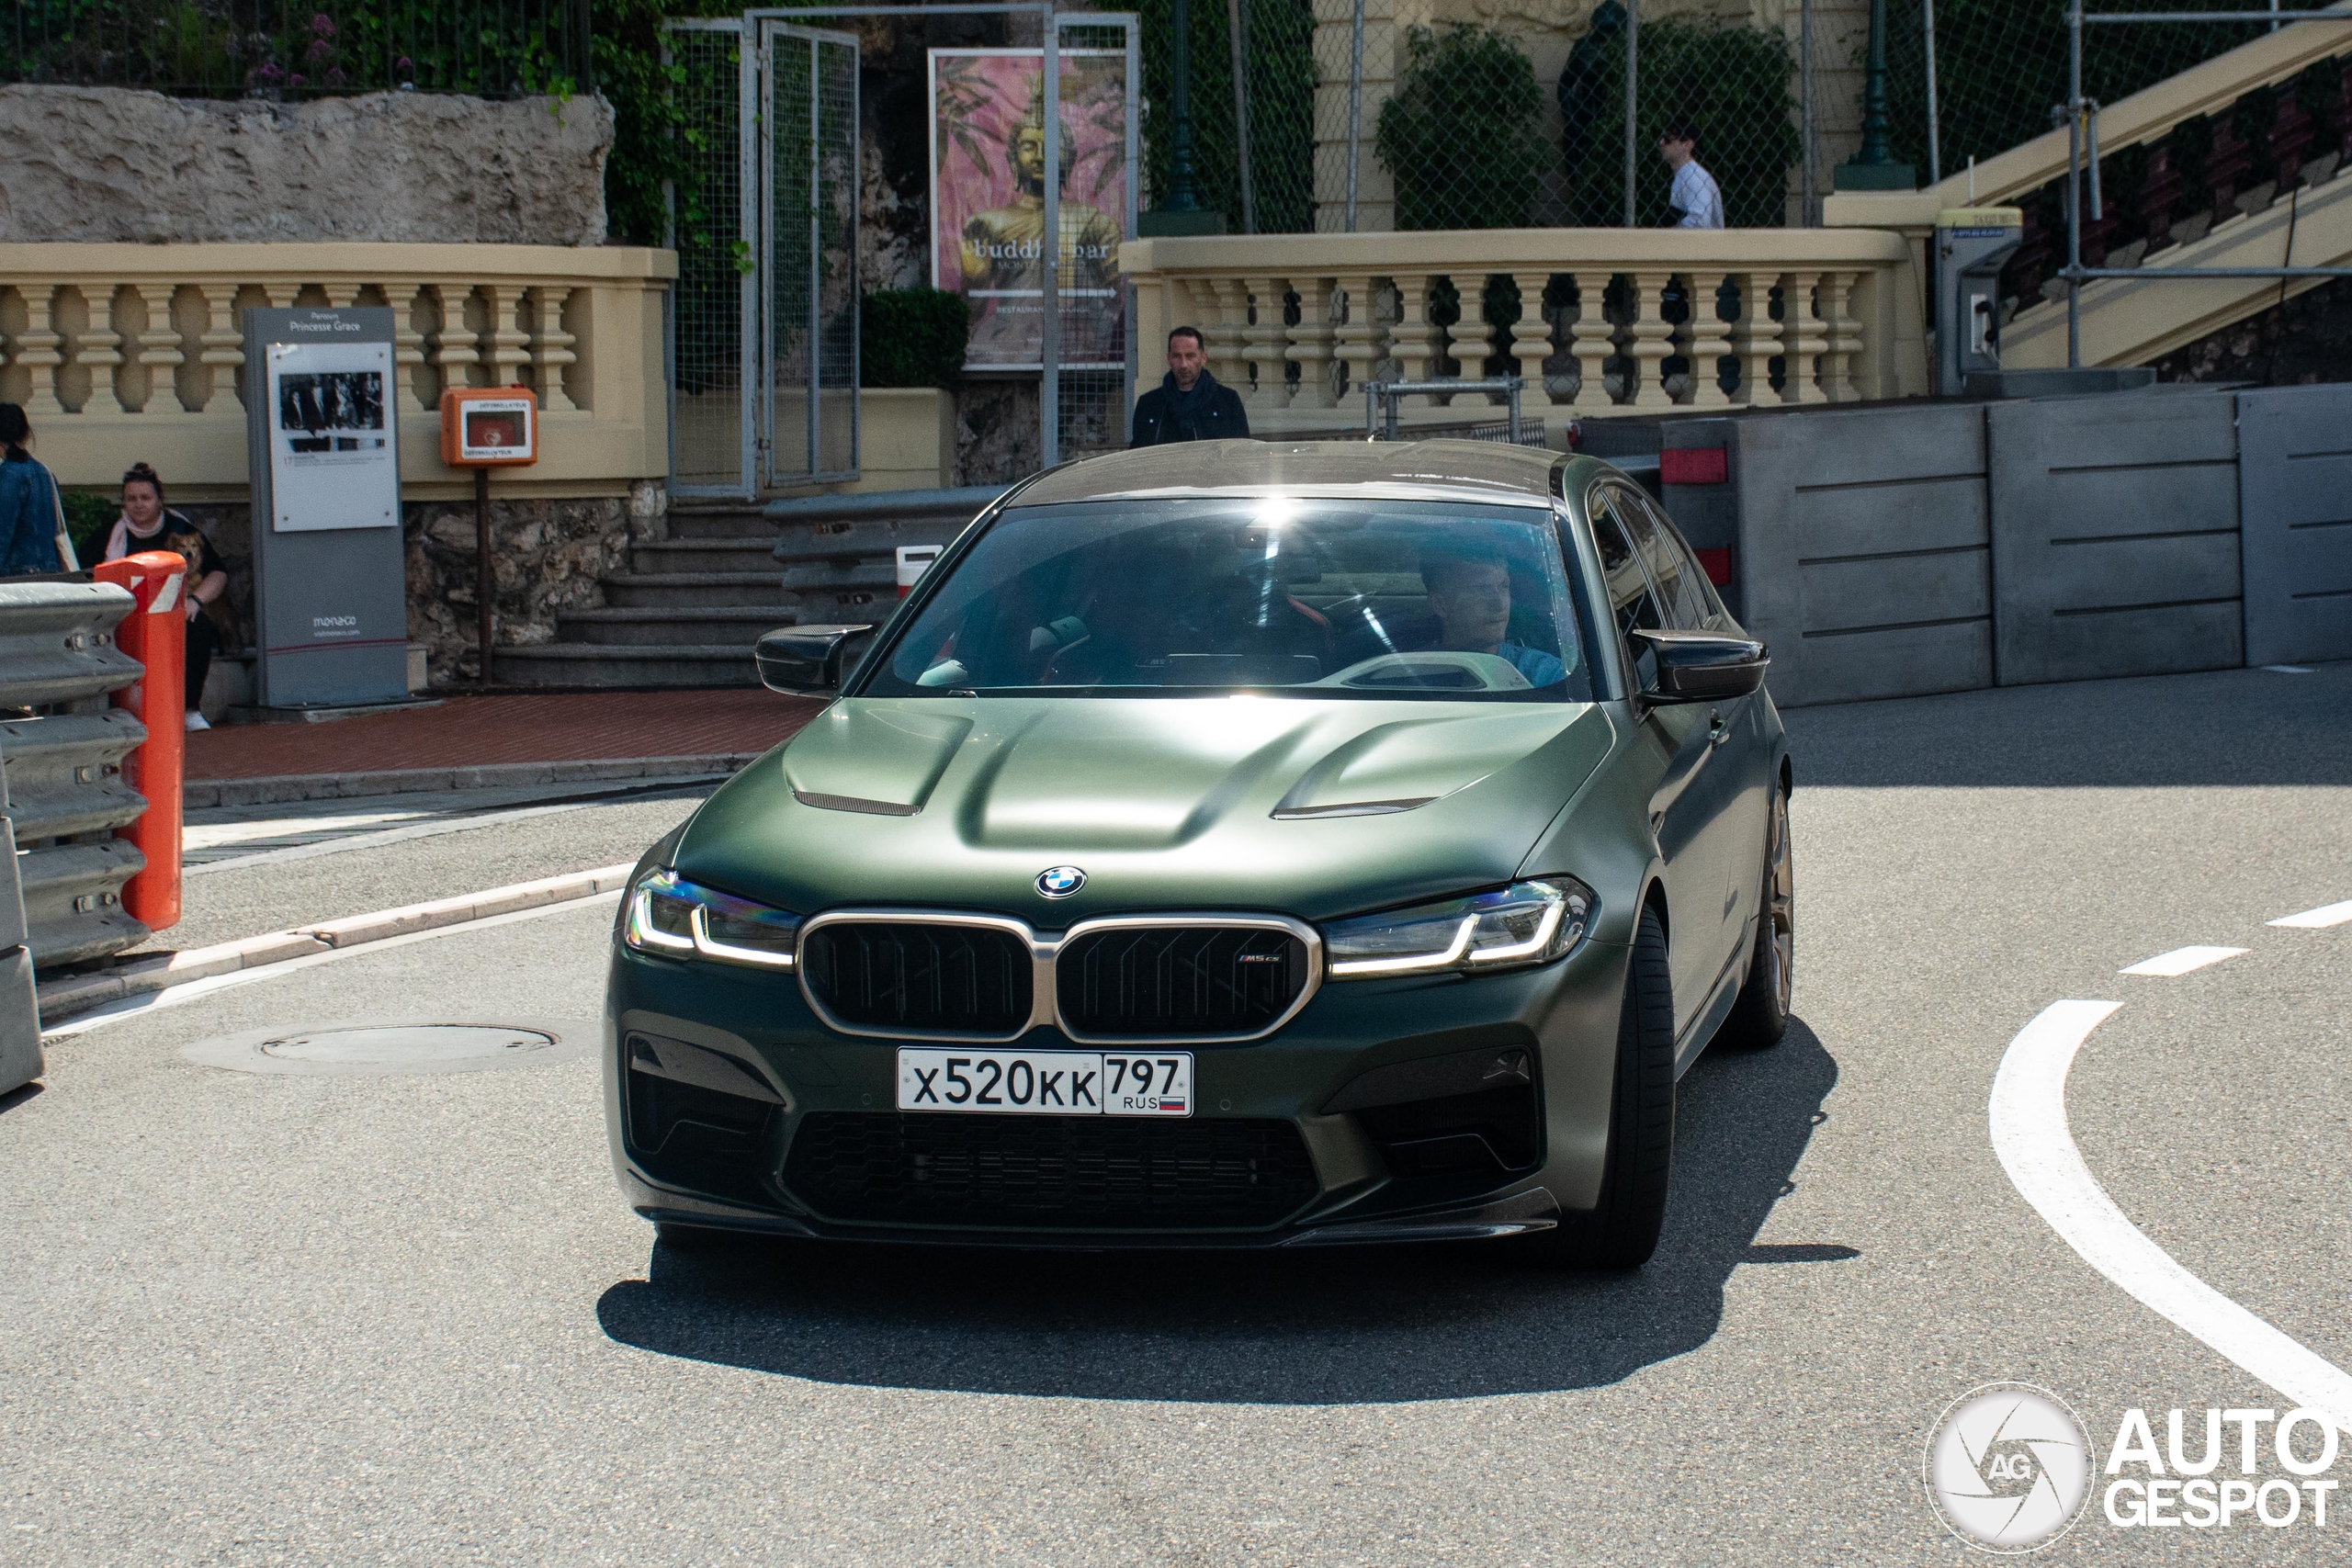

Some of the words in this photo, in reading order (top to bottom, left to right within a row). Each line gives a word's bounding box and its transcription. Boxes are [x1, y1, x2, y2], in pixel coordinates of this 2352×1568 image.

[1072, 238, 1111, 259] bar
[997, 306, 1046, 314] RESTAURAN
[290, 321, 332, 332] Princesse
[334, 321, 361, 332] Grace
[313, 615, 356, 626] monaco
[1106, 1058, 1180, 1095] 797
[1123, 1097, 1159, 1110] RUS
